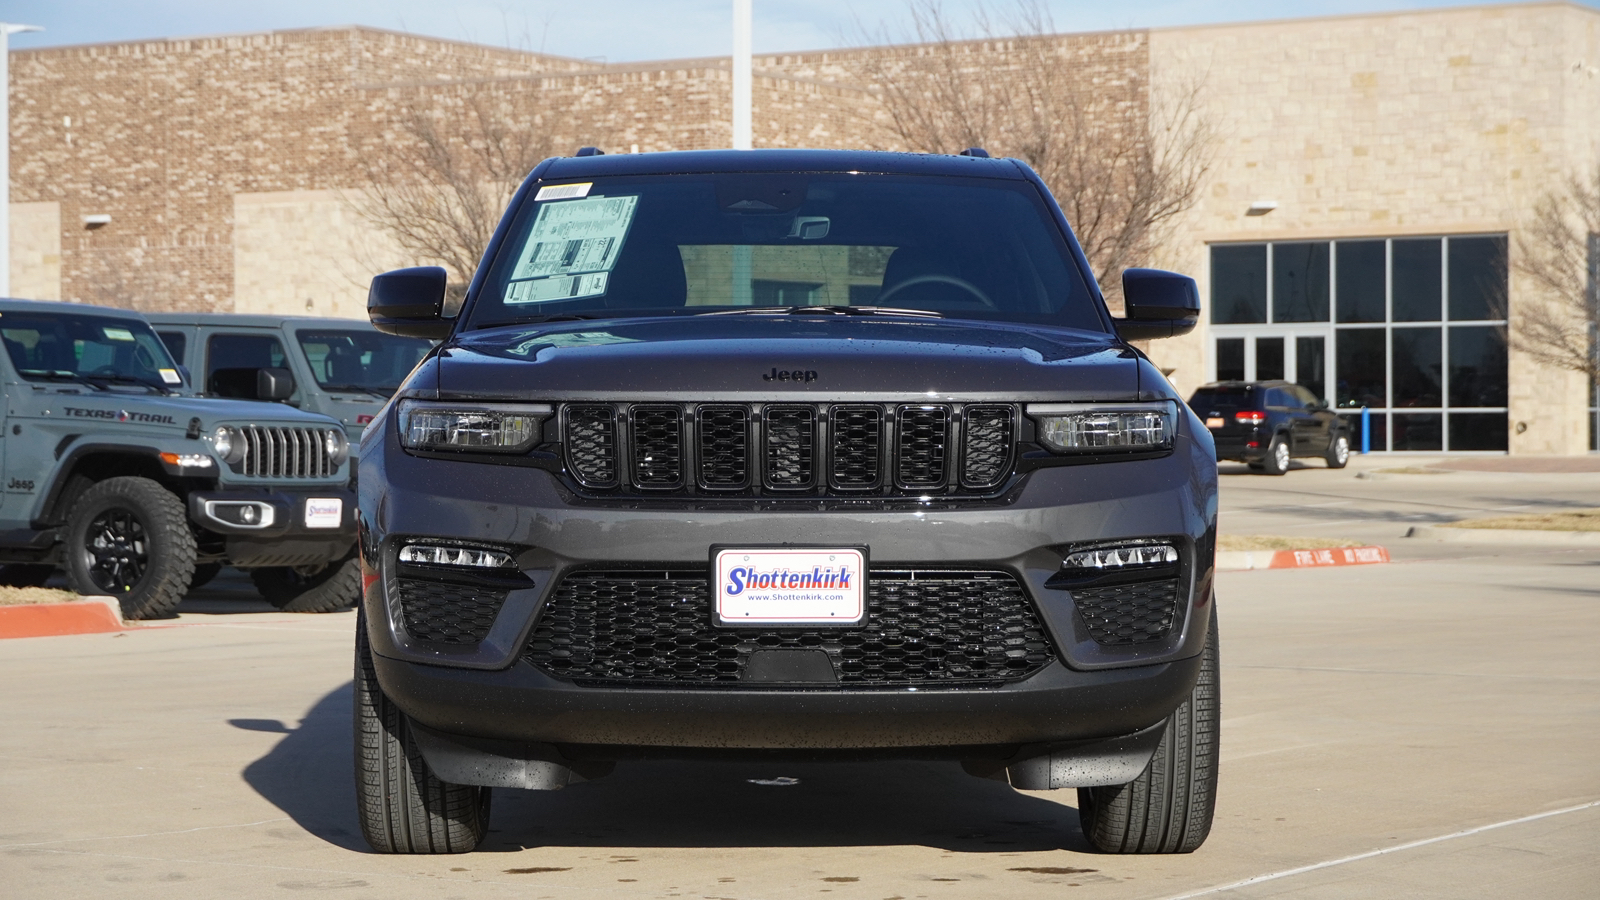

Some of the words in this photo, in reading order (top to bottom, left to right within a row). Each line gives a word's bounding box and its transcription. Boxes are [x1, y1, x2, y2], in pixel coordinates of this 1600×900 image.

[763, 368, 818, 384] Jeep
[63, 407, 116, 419] TEXAS
[127, 411, 177, 425] TRAIL
[8, 477, 35, 491] Jeep
[1293, 550, 1314, 566] FIRE
[1312, 549, 1335, 565] LANE
[726, 566, 852, 595] Shottenkirk
[748, 593, 844, 601] www.Shottenkirk.com
